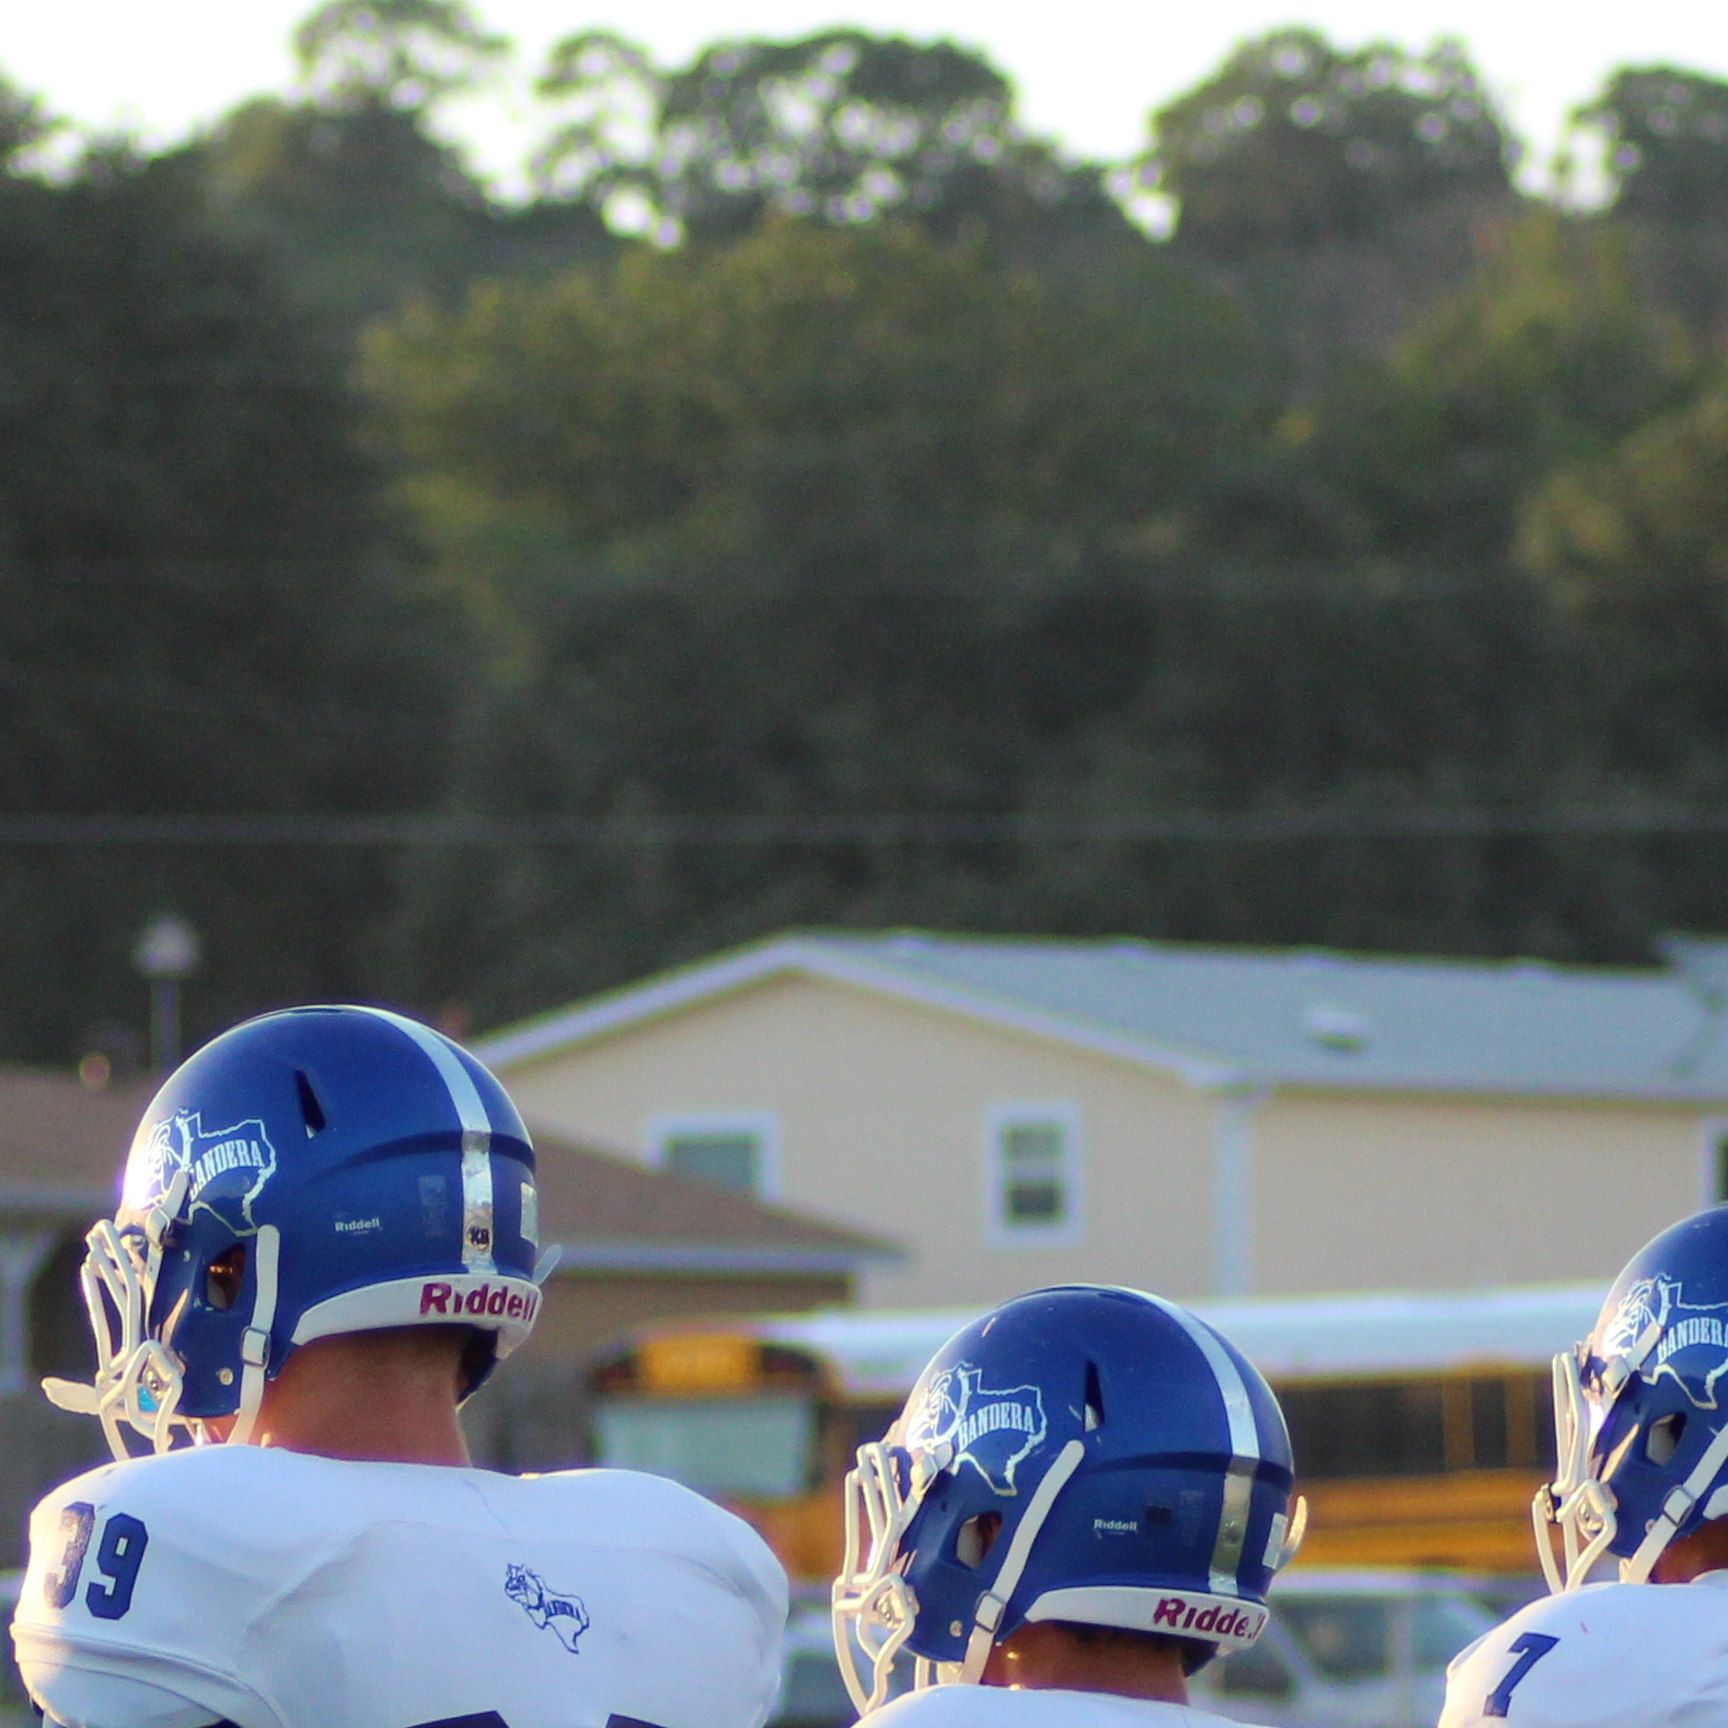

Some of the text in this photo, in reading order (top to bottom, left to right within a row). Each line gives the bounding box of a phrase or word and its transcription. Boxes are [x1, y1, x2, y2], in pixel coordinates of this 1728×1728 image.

[334, 1217, 380, 1232] Riddell
[420, 1282, 537, 1322] Riddell
[958, 1402, 1035, 1453] BANDERA
[1093, 1518, 1138, 1532] Riddell
[43, 1501, 148, 1620] 39
[1482, 1631, 1561, 1717] 7
